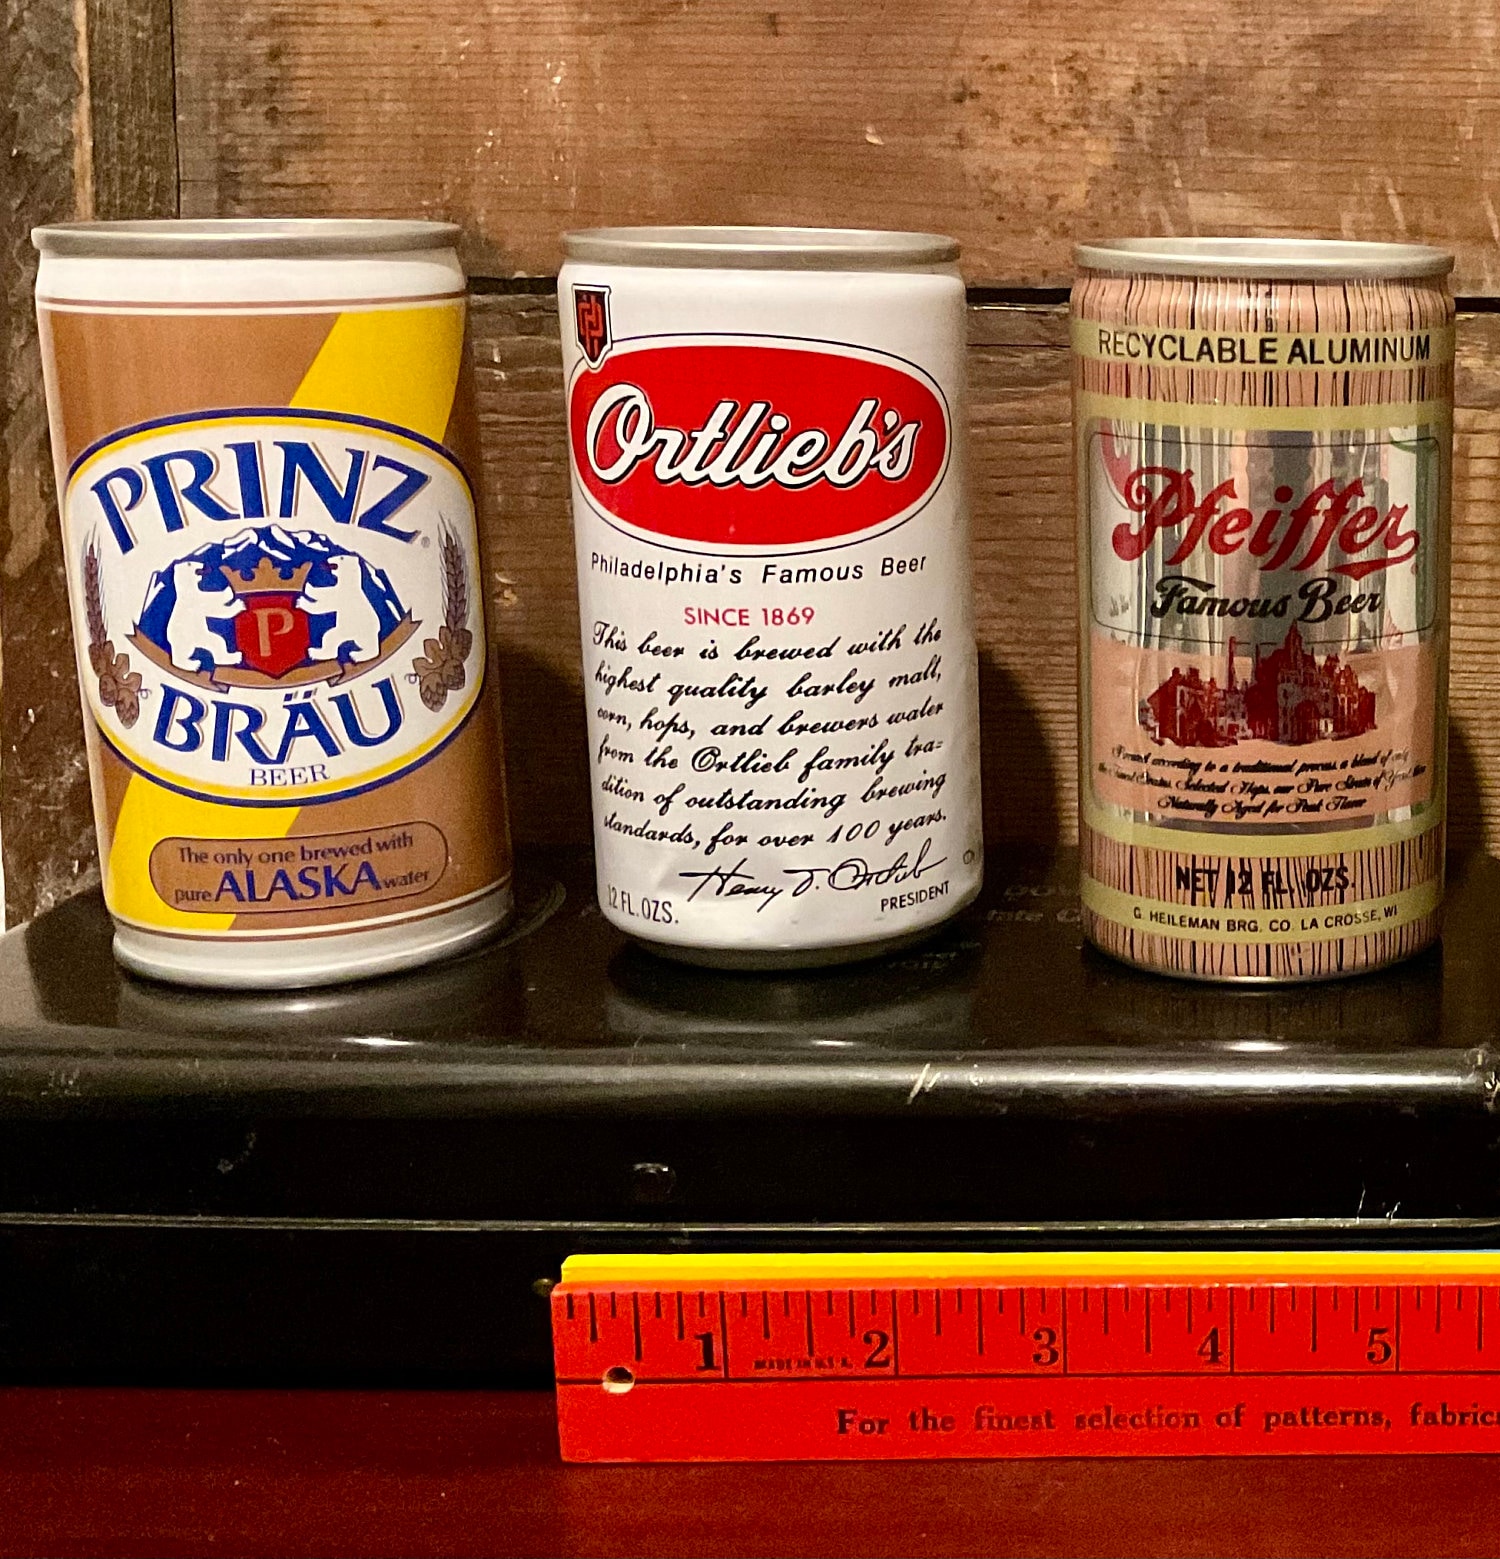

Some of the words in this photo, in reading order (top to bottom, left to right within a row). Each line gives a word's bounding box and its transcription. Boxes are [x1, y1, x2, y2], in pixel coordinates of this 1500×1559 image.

[1098, 329, 1278, 364] RECYCLABLE
[1287, 335, 1430, 365] ALUMINUM
[586, 382, 923, 490] Ortlieb's
[90, 439, 432, 555] PRINZ
[1112, 466, 1420, 581] Pfeiffer
[591, 551, 742, 585] Philadelphia's
[761, 561, 864, 585] Famous
[881, 554, 927, 577] Beer
[684, 607, 750, 626] SINCE
[761, 607, 815, 626] 1869
[1150, 575, 1296, 619] Famous
[1295, 576, 1381, 624] Beer
[251, 607, 296, 656] P
[593, 621, 627, 651] This
[638, 630, 684, 659] beer
[700, 640, 718, 660] is
[734, 636, 841, 661] brewed
[848, 625, 902, 655] with
[913, 618, 942, 645] the
[595, 660, 661, 695] highest
[667, 677, 767, 708] quality
[786, 671, 875, 703] barley
[888, 654, 942, 690] malt,
[153, 675, 406, 764] BRÄU
[597, 705, 633, 732] corn,
[640, 711, 696, 743] hops,
[711, 714, 773, 737] and
[777, 712, 878, 737] brewers
[887, 695, 944, 724] water
[249, 763, 330, 787] BEER
[597, 734, 634, 764] from
[644, 745, 678, 770] the
[691, 746, 790, 774] Ortlieb
[798, 745, 895, 784] family
[601, 775, 644, 802] dition
[653, 783, 686, 815] of
[685, 786, 847, 819] outstanding
[860, 769, 946, 804] brewing
[178, 846, 208, 864] The
[213, 848, 251, 867] only
[258, 849, 295, 863] one
[300, 838, 373, 860] brewed
[375, 832, 414, 853] with
[603, 814, 700, 850] standards,
[705, 822, 748, 855] for
[757, 833, 814, 847] over
[826, 819, 879, 844] 100
[888, 809, 946, 845] years.
[174, 888, 213, 903] pure
[214, 861, 382, 902] ALASKA
[383, 868, 429, 889] water
[880, 880, 950, 913] PRESIDENT
[1176, 866, 1218, 893] NET
[1228, 867, 1252, 895] 12
[1304, 866, 1356, 893] OZS.
[607, 884, 618, 909] 12
[620, 890, 639, 918] FL.
[641, 899, 679, 924] OZS.
[1150, 910, 1220, 930] HEILEMAN
[1300, 917, 1319, 931] LA
[1324, 909, 1382, 927] CROSSE,
[1384, 905, 1397, 918] WI
[695, 1332, 722, 1371] 1
[862, 1329, 891, 1369] 2
[1032, 1327, 1060, 1367] 3
[1199, 1327, 1223, 1365] 4
[1366, 1327, 1392, 1365] 5
[837, 1408, 890, 1436] For
[909, 1407, 956, 1433] the
[974, 1405, 1055, 1431] finest
[1074, 1404, 1199, 1431] selection
[1214, 1403, 1246, 1429] of
[1264, 1405, 1392, 1433] patterns,
